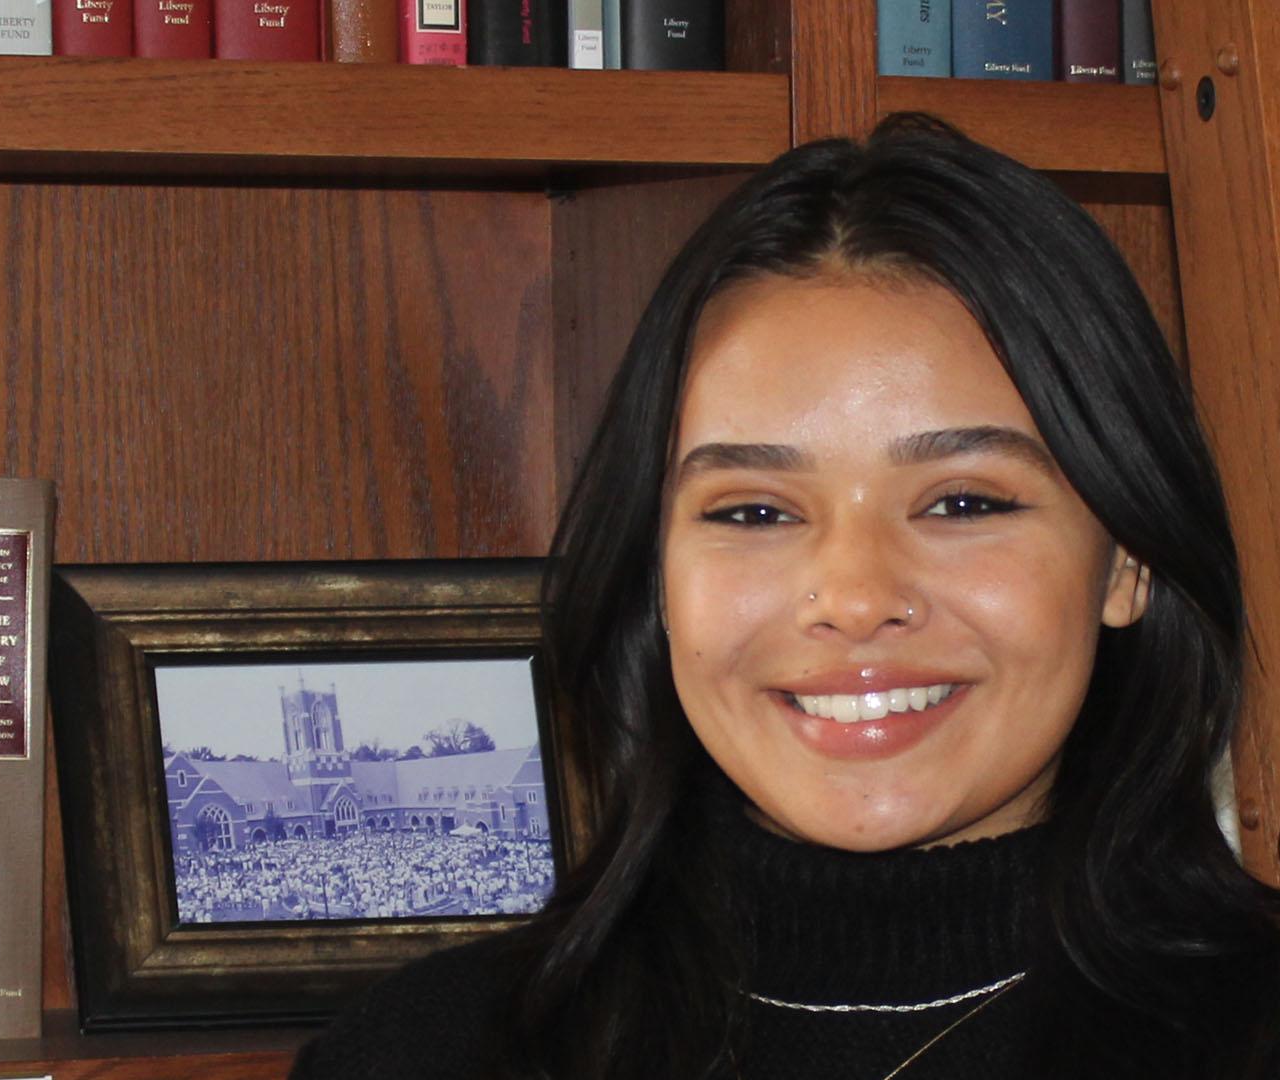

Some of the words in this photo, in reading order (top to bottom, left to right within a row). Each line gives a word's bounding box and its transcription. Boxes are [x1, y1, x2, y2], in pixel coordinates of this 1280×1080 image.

[254, 3, 290, 15] Liberty
[259, 16, 285, 28] Fund
[1, 30, 30, 39] FUND
